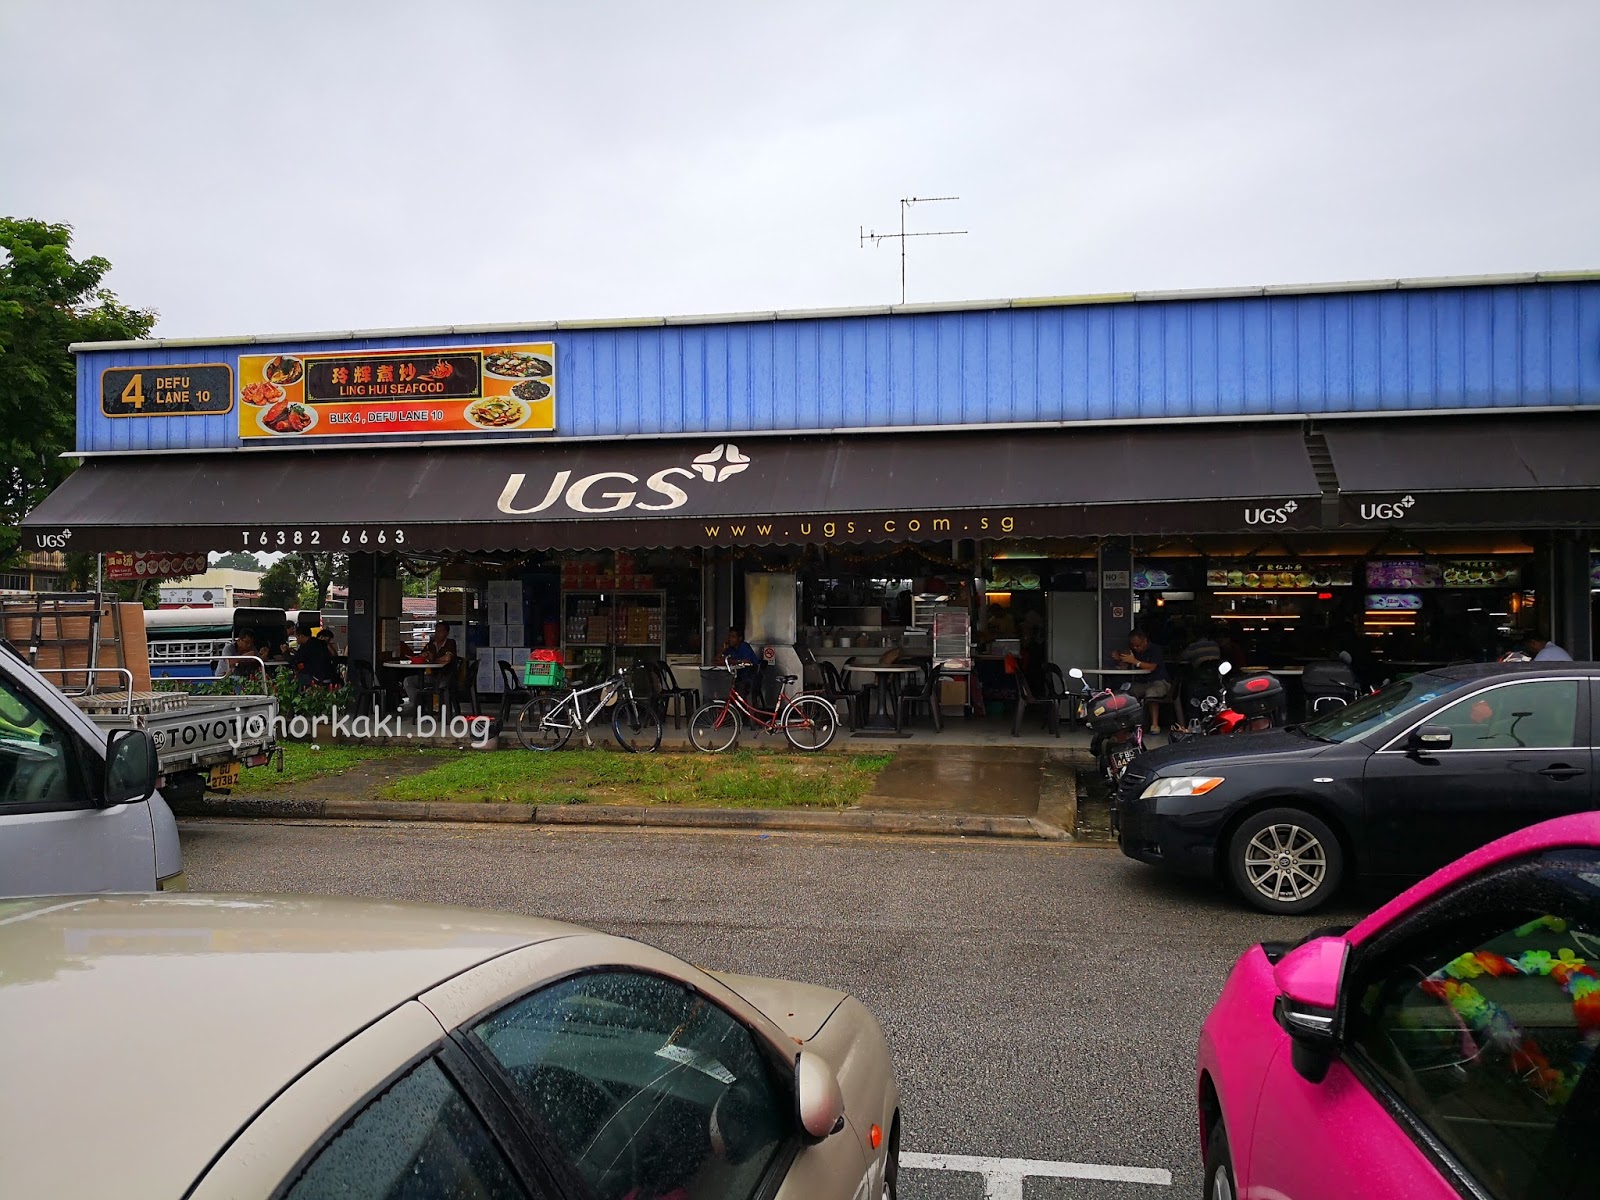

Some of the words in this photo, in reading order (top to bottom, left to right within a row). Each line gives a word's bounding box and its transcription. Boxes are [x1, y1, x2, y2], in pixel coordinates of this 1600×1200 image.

[331, 363, 417, 385] 玲辉煮炒
[156, 376, 190, 390] DEFU
[339, 384, 366, 396] LING
[368, 384, 388, 395] HUI
[390, 382, 445, 394] SEAFOOD
[121, 373, 145, 409] 4
[156, 390, 190, 404] LANE
[195, 390, 211, 403] 10
[329, 412, 352, 424] BLK
[368, 411, 397, 422] DEFU
[399, 411, 428, 421] LANE
[431, 410, 444, 420] 10
[497, 467, 696, 514] UGS
[1244, 508, 1288, 525] UGS
[1361, 503, 1405, 520] UGS
[704, 515, 1014, 538] www.ugs.com.sg
[36, 534, 66, 548] UGS
[341, 529, 405, 544] 6663
[153, 733, 165, 745] 60
[219, 765, 231, 775] GU
[212, 773, 239, 788] 2738Z
